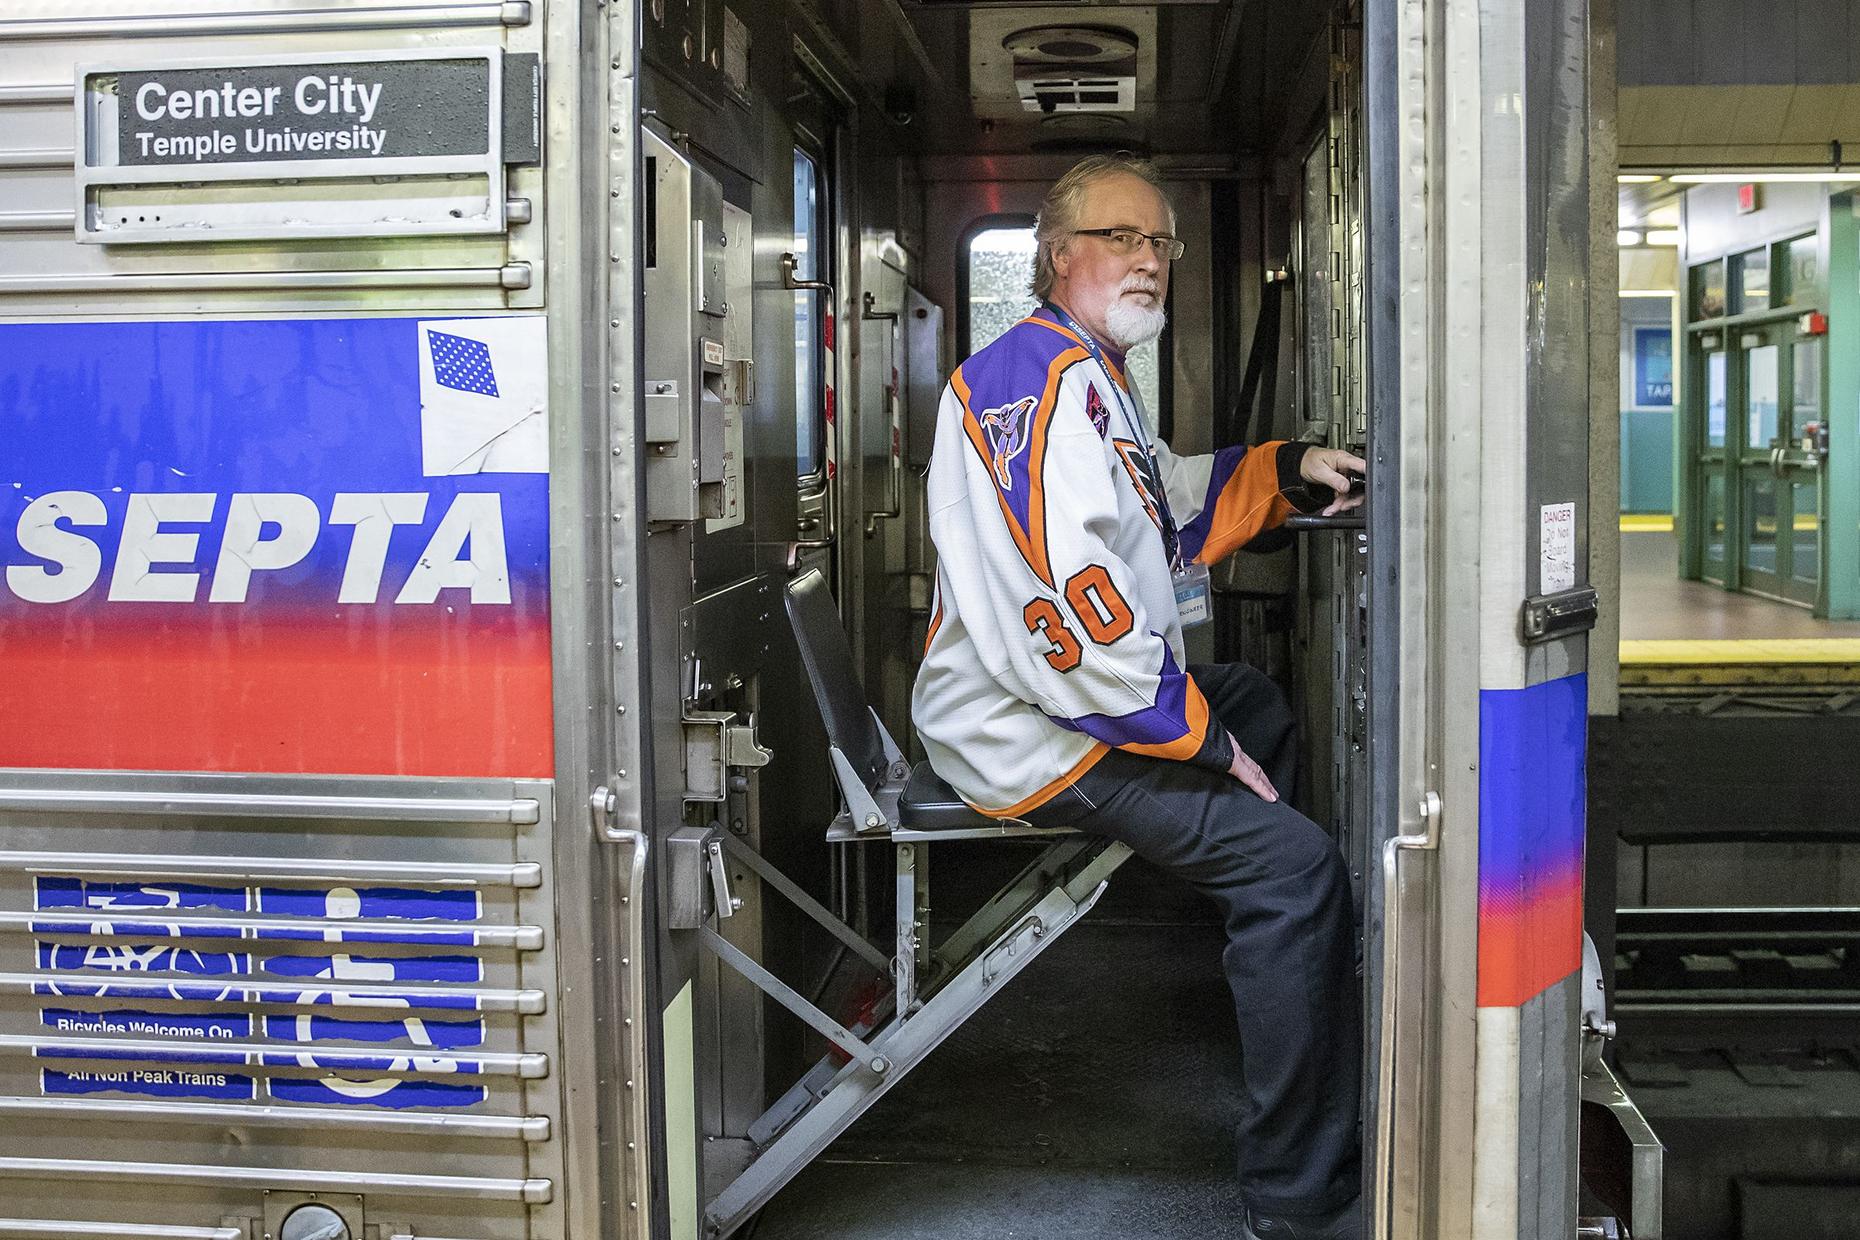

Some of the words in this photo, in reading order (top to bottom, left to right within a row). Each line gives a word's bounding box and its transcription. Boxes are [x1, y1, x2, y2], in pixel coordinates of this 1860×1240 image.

[135, 81, 281, 122] Center
[293, 75, 383, 122] City
[135, 130, 236, 160] Temple
[244, 125, 387, 155] University
[1543, 509, 1571, 524] DANGER
[1557, 526, 1569, 539] Not
[5, 491, 512, 605] SEPTA
[1023, 563, 1135, 674] 30
[57, 1018, 126, 1033] Bicycles
[129, 1021, 204, 1037] Welcome
[208, 1025, 233, 1039] On
[95, 1071, 128, 1083] Non
[133, 1070, 173, 1085] Peak
[173, 1071, 226, 1087] Trains
